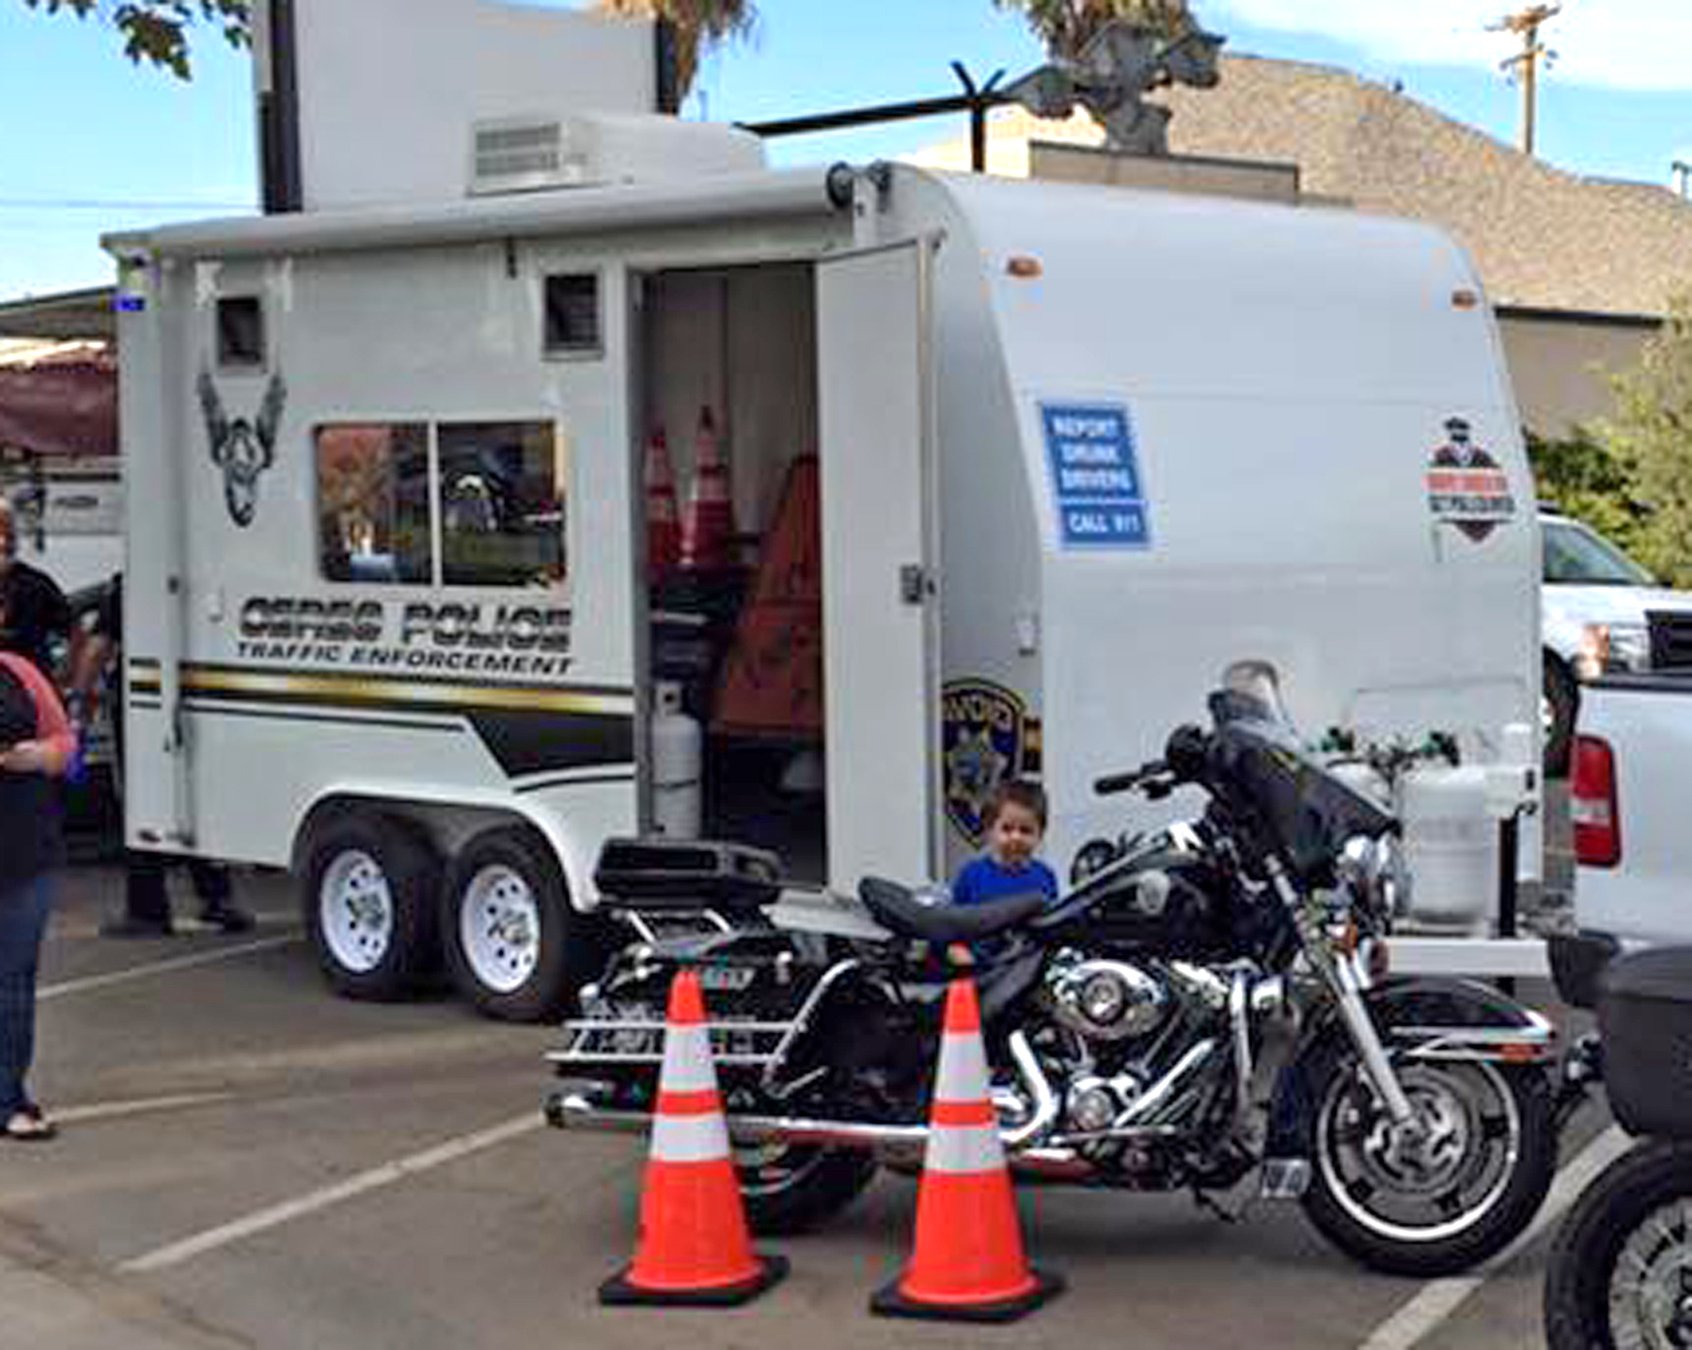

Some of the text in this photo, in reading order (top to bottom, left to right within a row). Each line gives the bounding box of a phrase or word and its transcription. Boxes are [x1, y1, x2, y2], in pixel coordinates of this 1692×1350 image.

[1069, 512, 1109, 534] CALL
[403, 602, 572, 653] POLICE
[236, 640, 574, 676] TRAFFIC ENFORCEMENT
